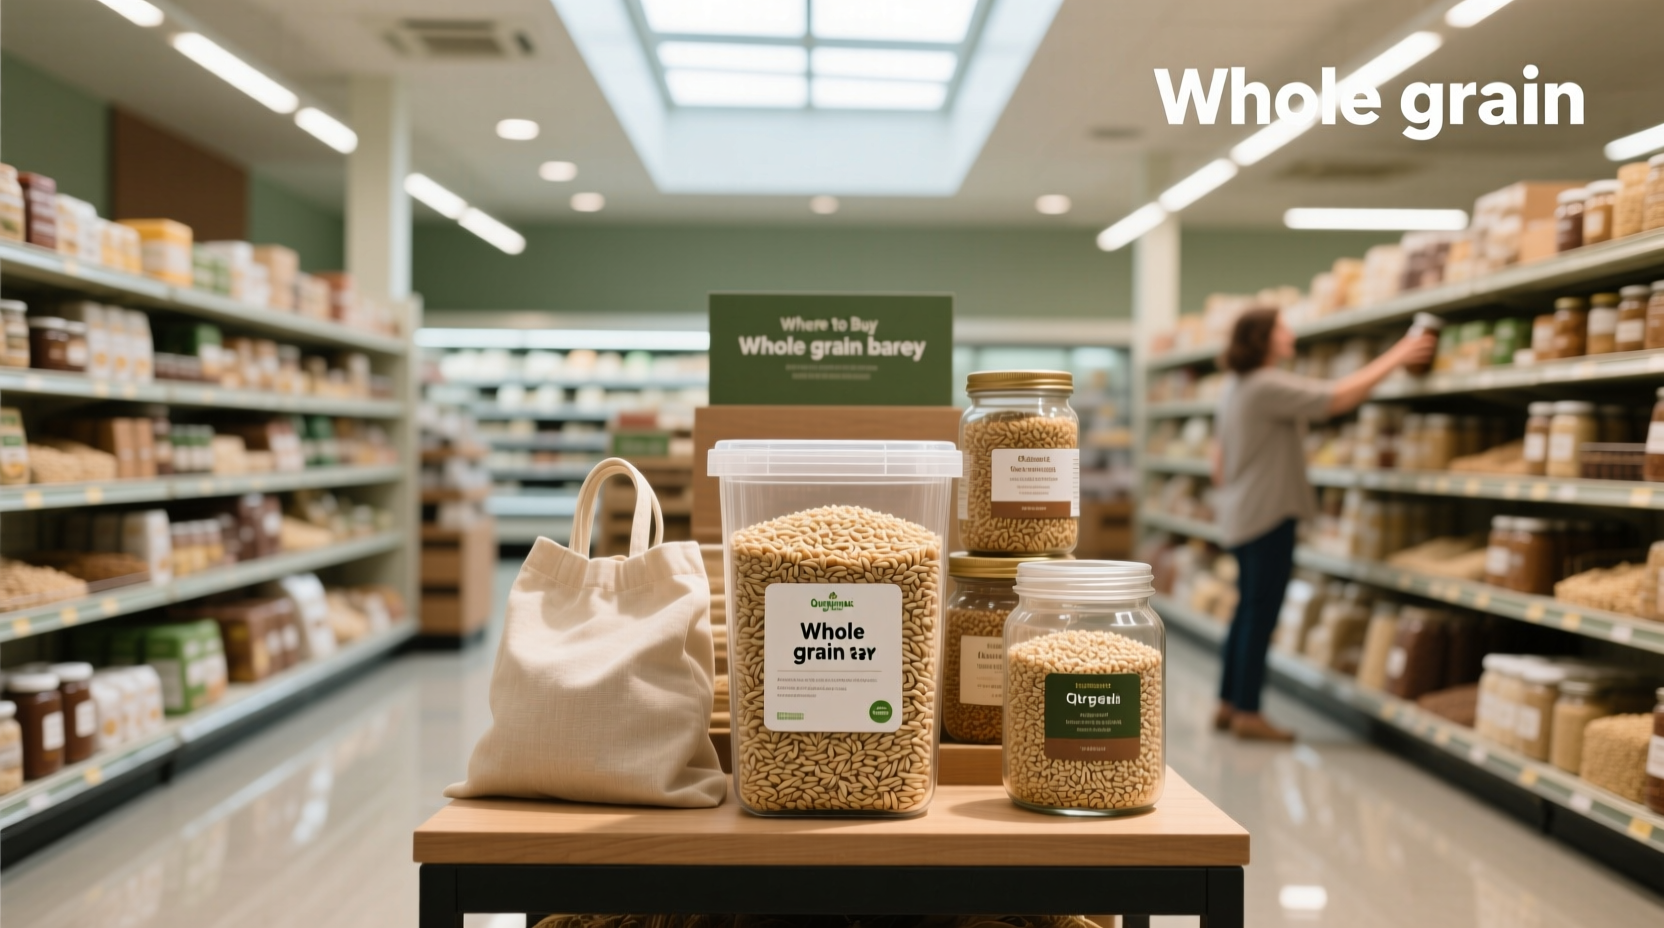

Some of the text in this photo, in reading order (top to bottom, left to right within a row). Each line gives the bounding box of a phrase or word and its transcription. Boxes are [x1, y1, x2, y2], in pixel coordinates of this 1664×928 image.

[780, 316, 879, 334] Where to Buy
[738, 335, 926, 361] Whole grain barey
[800, 622, 865, 640] Whole
[793, 643, 845, 665] grain
